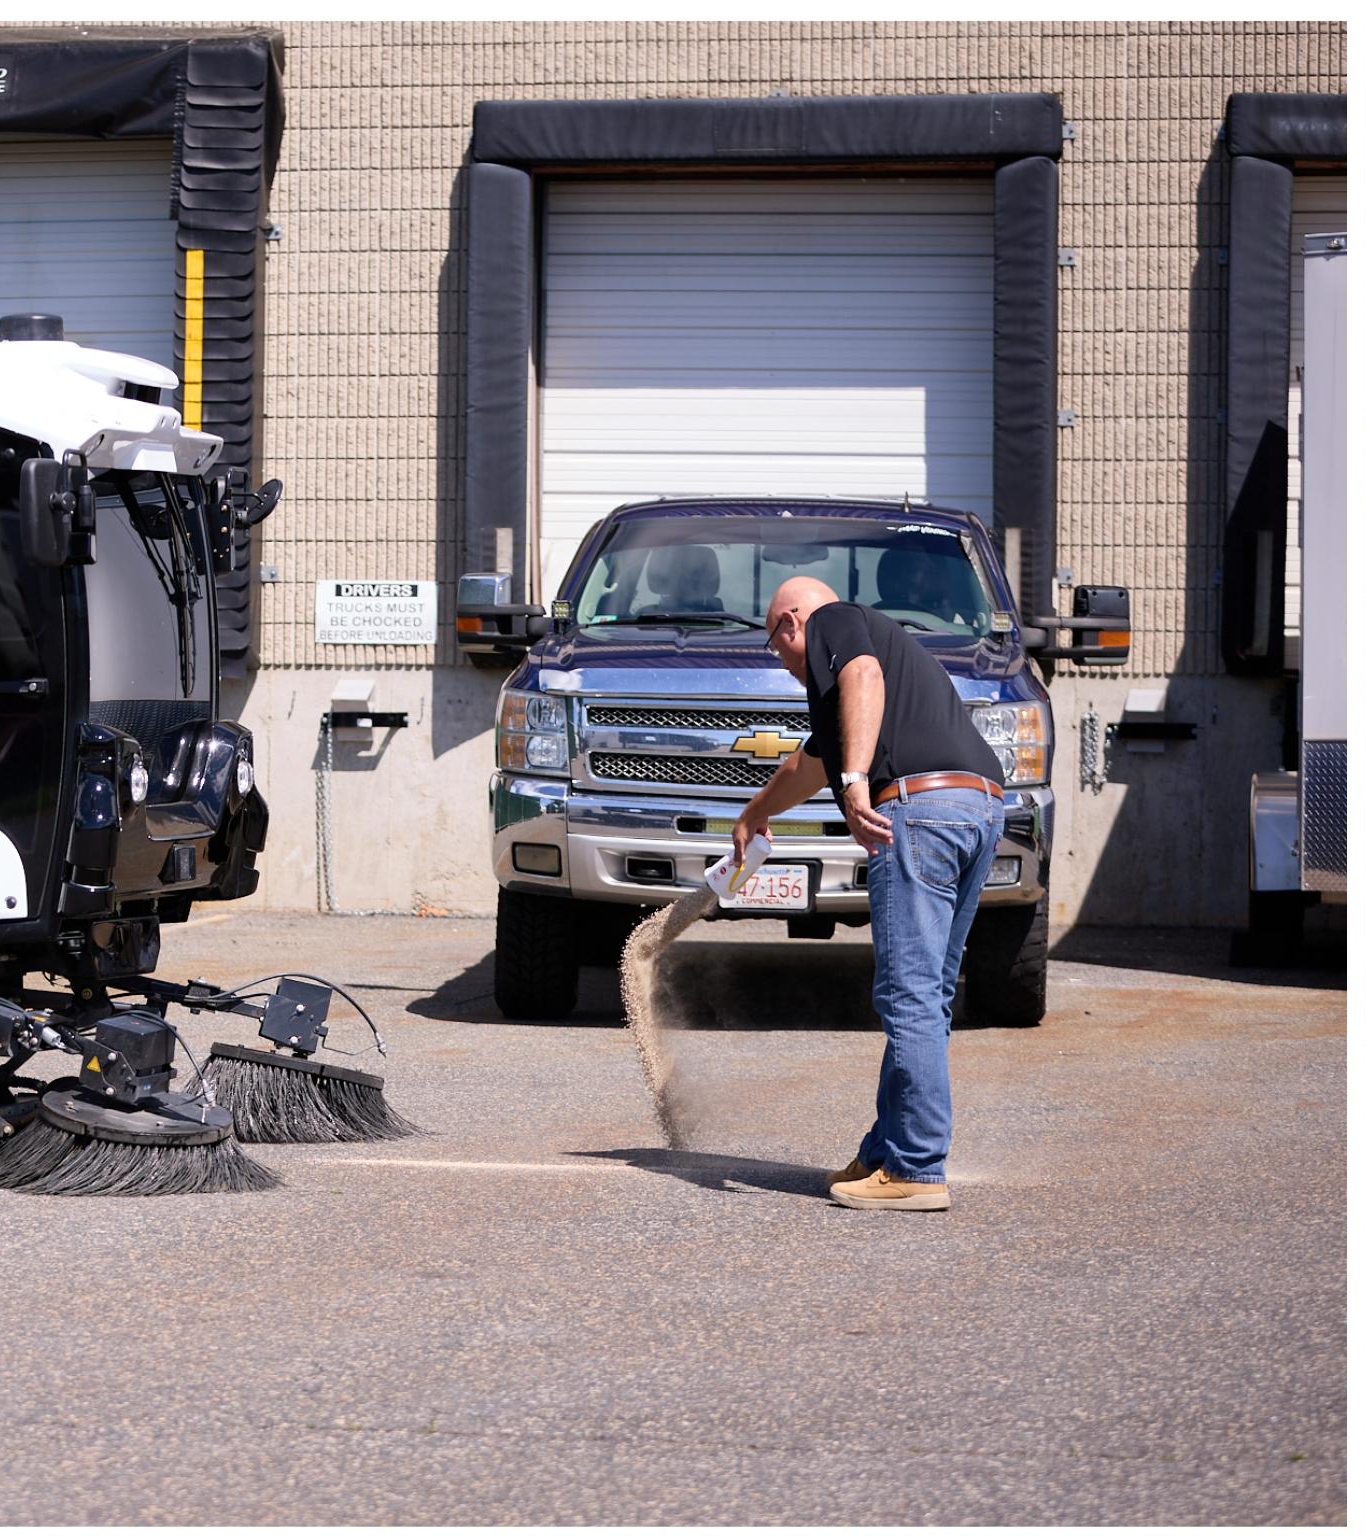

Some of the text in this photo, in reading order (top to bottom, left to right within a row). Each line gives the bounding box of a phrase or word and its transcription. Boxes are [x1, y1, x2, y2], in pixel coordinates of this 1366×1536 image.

[340, 584, 413, 597] DRIVERS
[327, 602, 425, 613] TRUCKS MUST
[330, 616, 423, 627] BE CHOCKED
[319, 630, 434, 641] BEFORE UNLOADING
